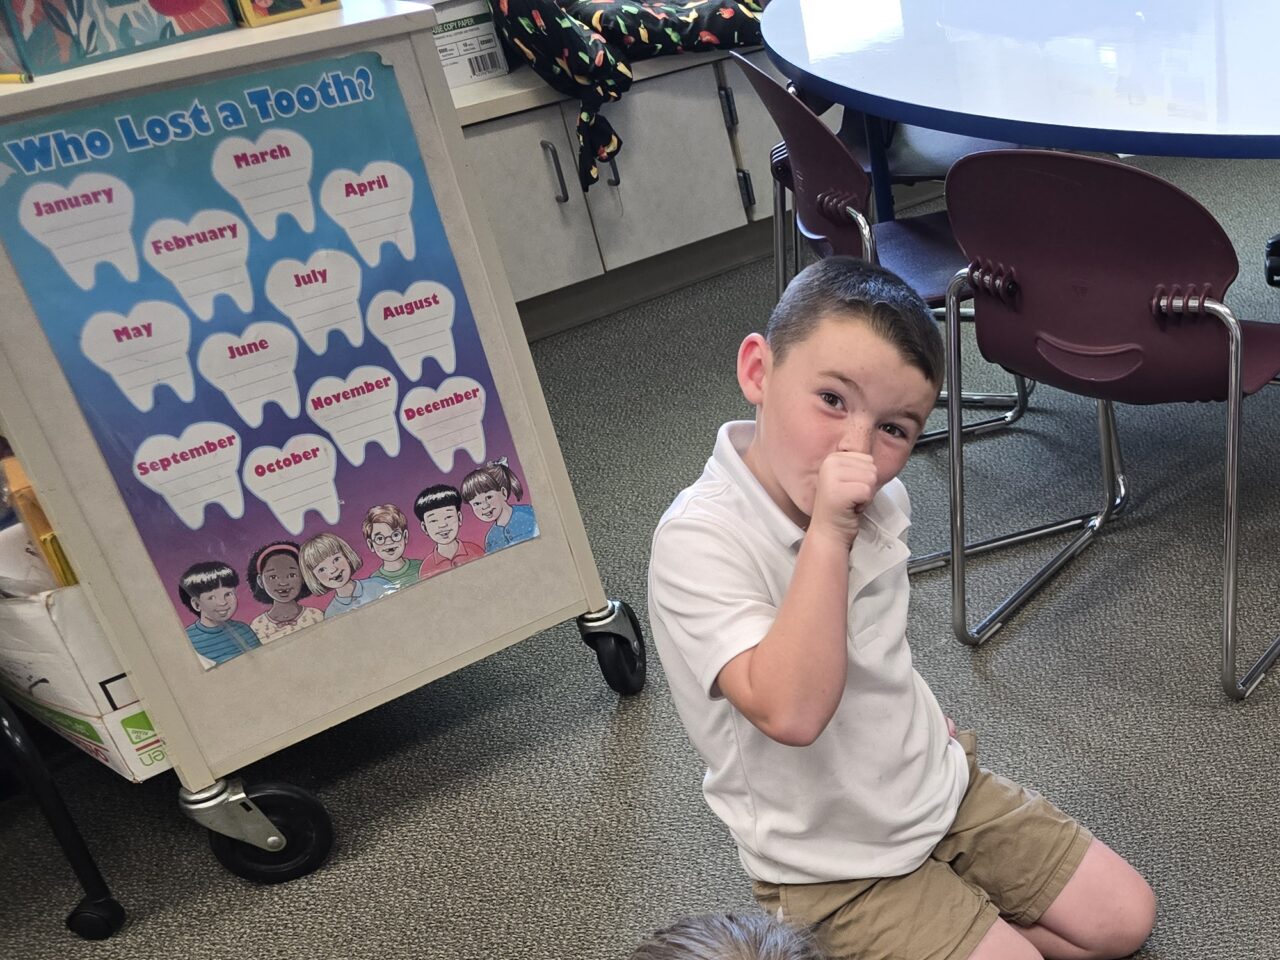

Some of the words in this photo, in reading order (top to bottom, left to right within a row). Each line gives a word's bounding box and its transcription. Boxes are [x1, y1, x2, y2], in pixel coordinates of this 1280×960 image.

[443, 21, 457, 31] COPY
[457, 17, 475, 28] PAPER
[4, 129, 114, 176] Who
[116, 100, 213, 152] Lost
[217, 100, 246, 128] a
[245, 67, 376, 123] Tooth?
[233, 144, 291, 167] March
[344, 175, 388, 196] April
[34, 188, 113, 215] January
[152, 223, 238, 253] February
[294, 269, 327, 287] July
[383, 293, 440, 319] August
[113, 323, 153, 341] May
[227, 339, 269, 358] June
[311, 377, 391, 410] November
[404, 387, 480, 420] December
[137, 435, 236, 475] September
[254, 447, 320, 476] October
